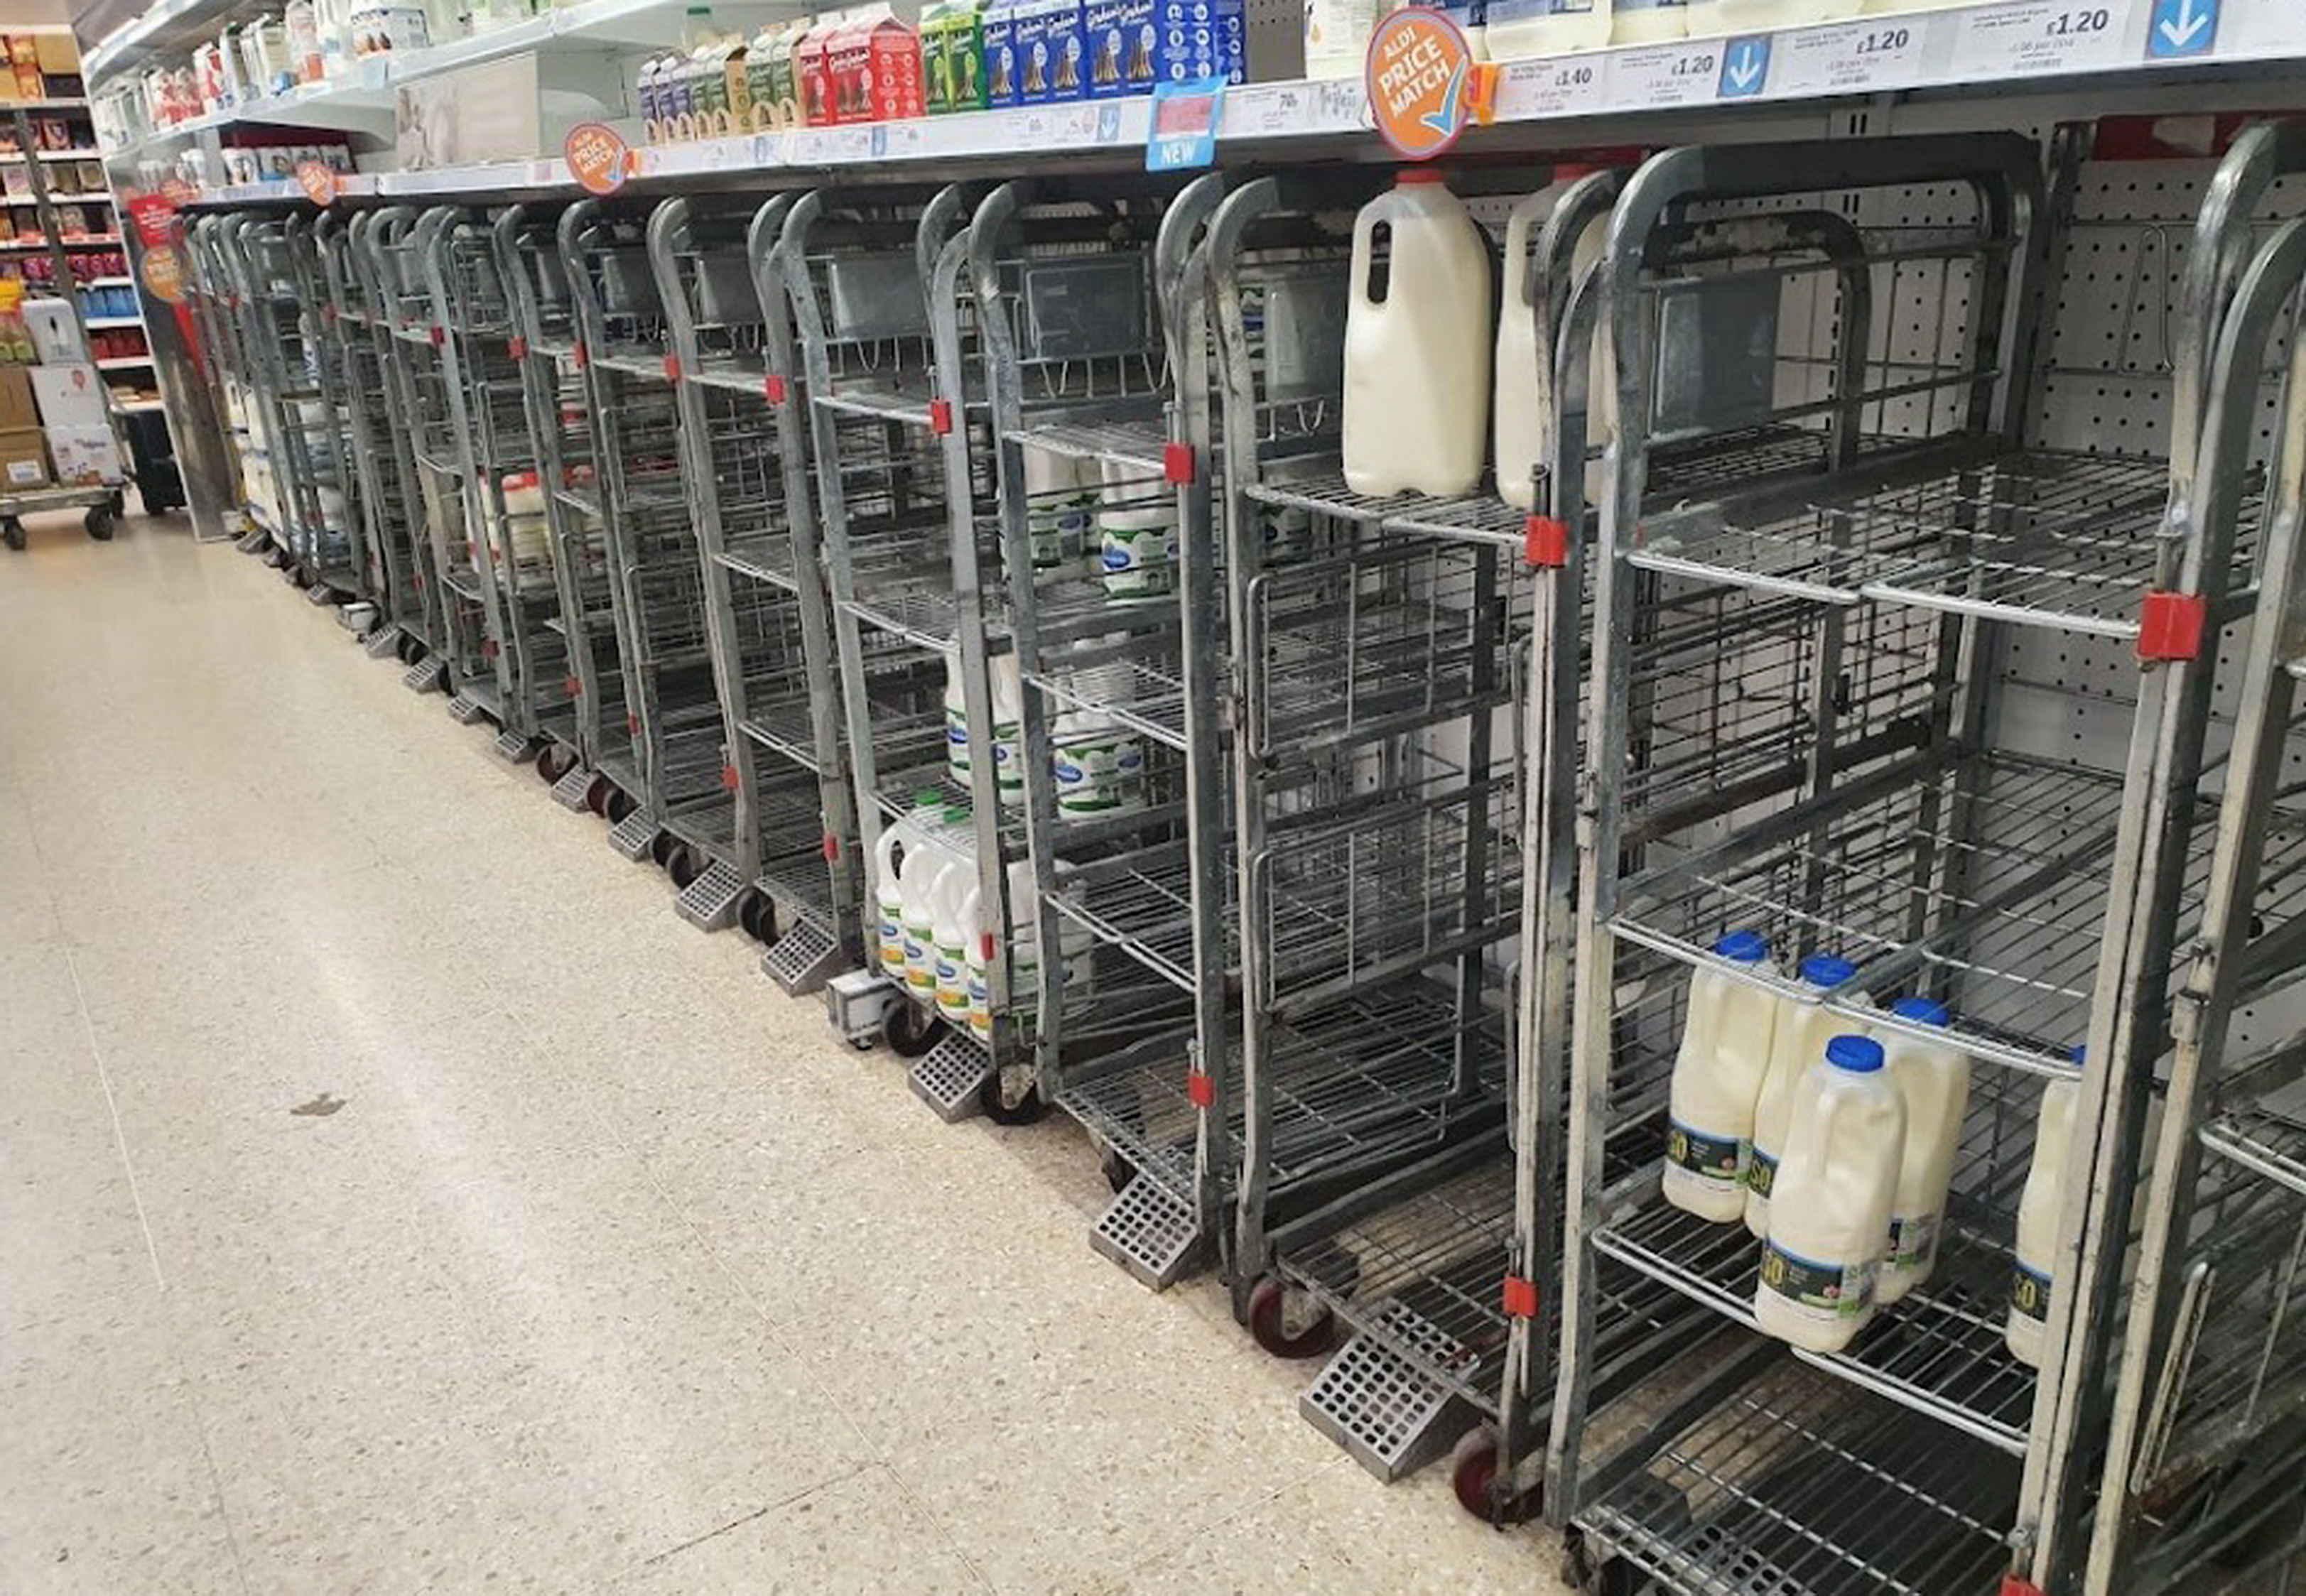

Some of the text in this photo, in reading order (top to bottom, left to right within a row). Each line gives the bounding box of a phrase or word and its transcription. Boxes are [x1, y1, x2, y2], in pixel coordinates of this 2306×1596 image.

[2046, 9, 2109, 35] £1.20
[1383, 26, 1417, 63] ALDI
[1857, 28, 1910, 54] £1.20
[1380, 35, 1442, 98] PRICE
[1672, 55, 1714, 77] £1.20
[1389, 58, 1451, 118] MATCH
[1161, 142, 1196, 164] NEW
